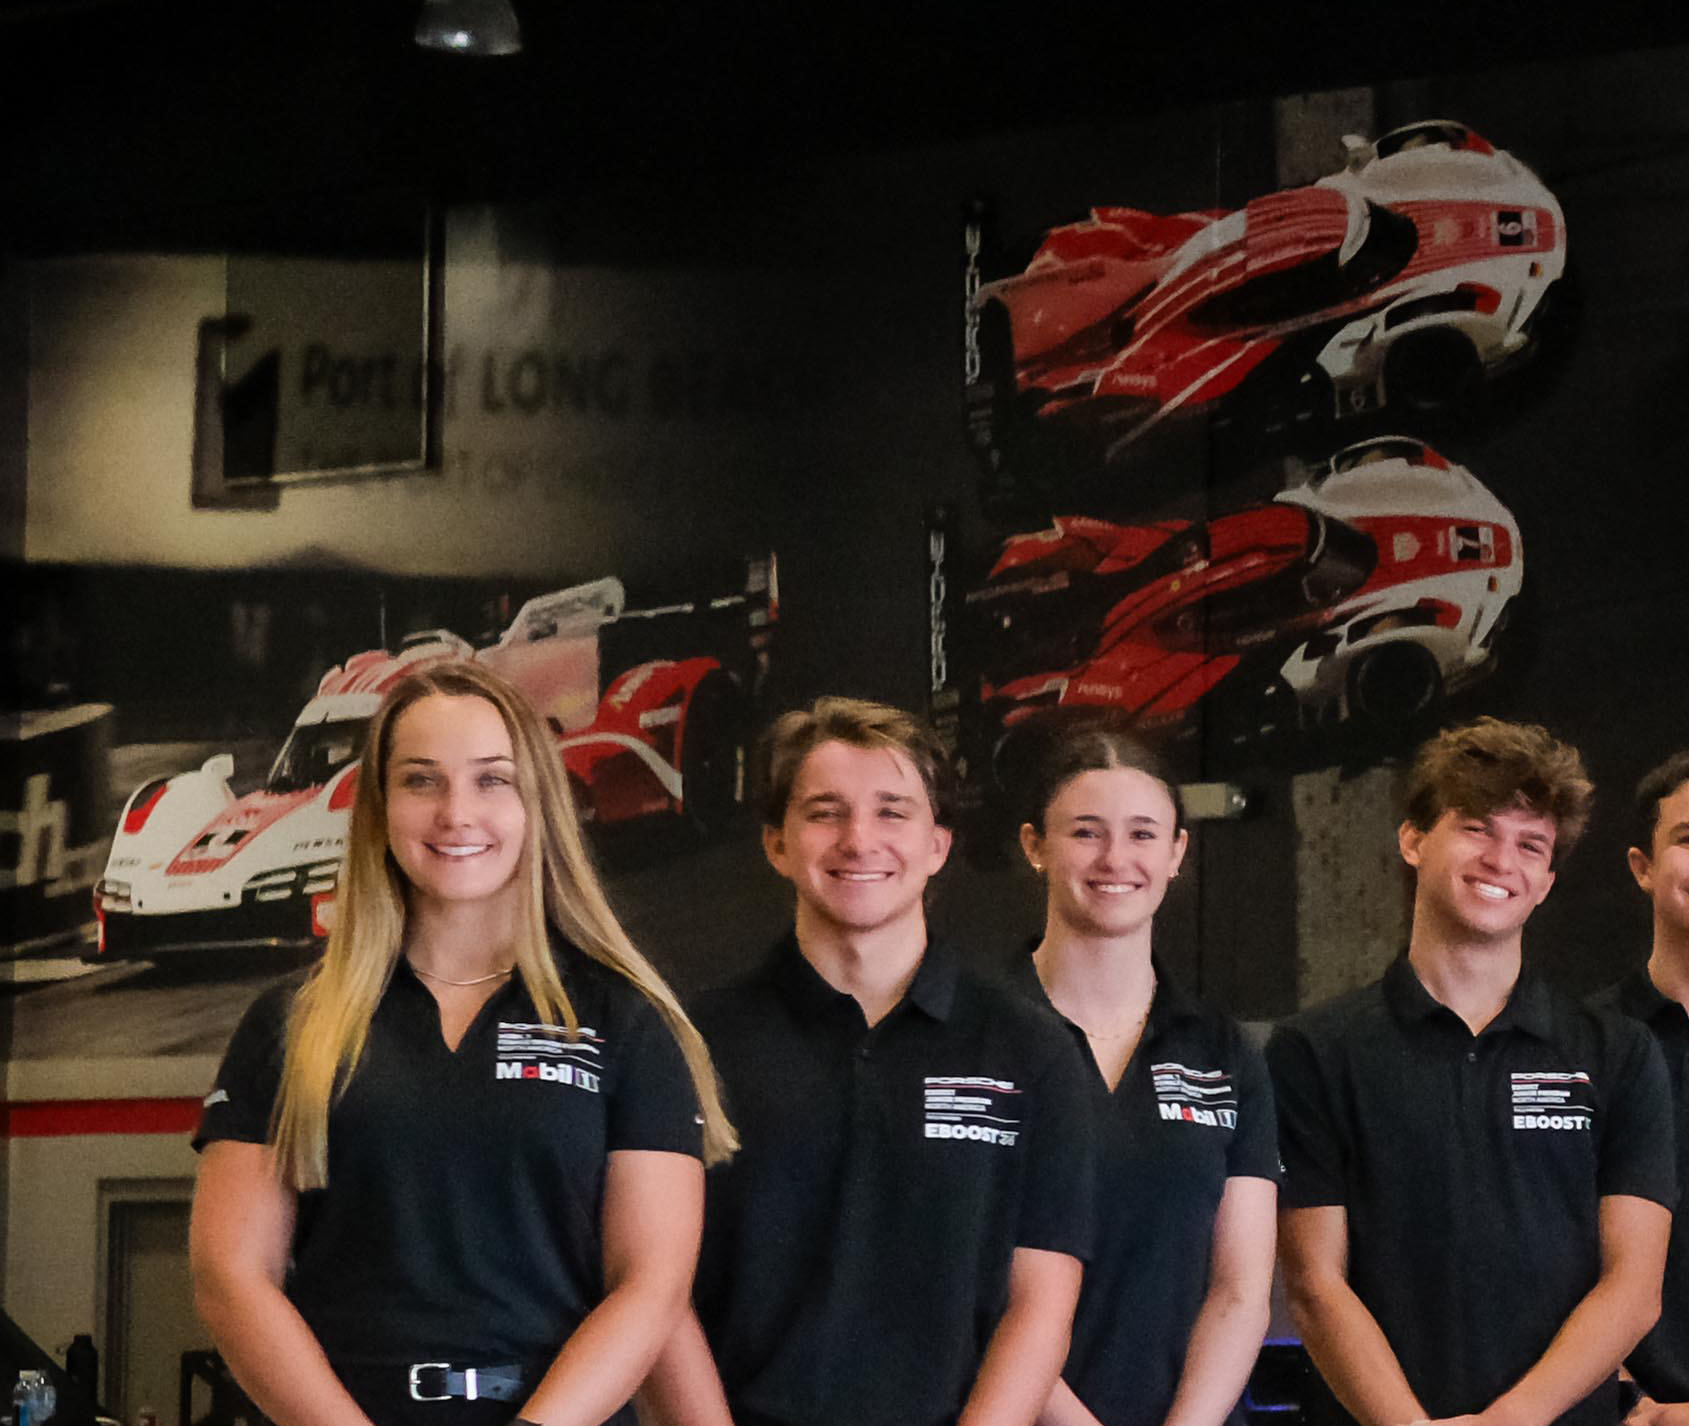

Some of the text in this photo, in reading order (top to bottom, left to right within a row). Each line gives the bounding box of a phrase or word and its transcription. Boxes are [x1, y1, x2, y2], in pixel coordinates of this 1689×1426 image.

[484, 348, 632, 417] LONG
[496, 1062, 573, 1085] Mobil
[1158, 1103, 1218, 1127] Mobil
[1513, 1115, 1586, 1130] EBOOST
[925, 1123, 999, 1144] EBOOST
